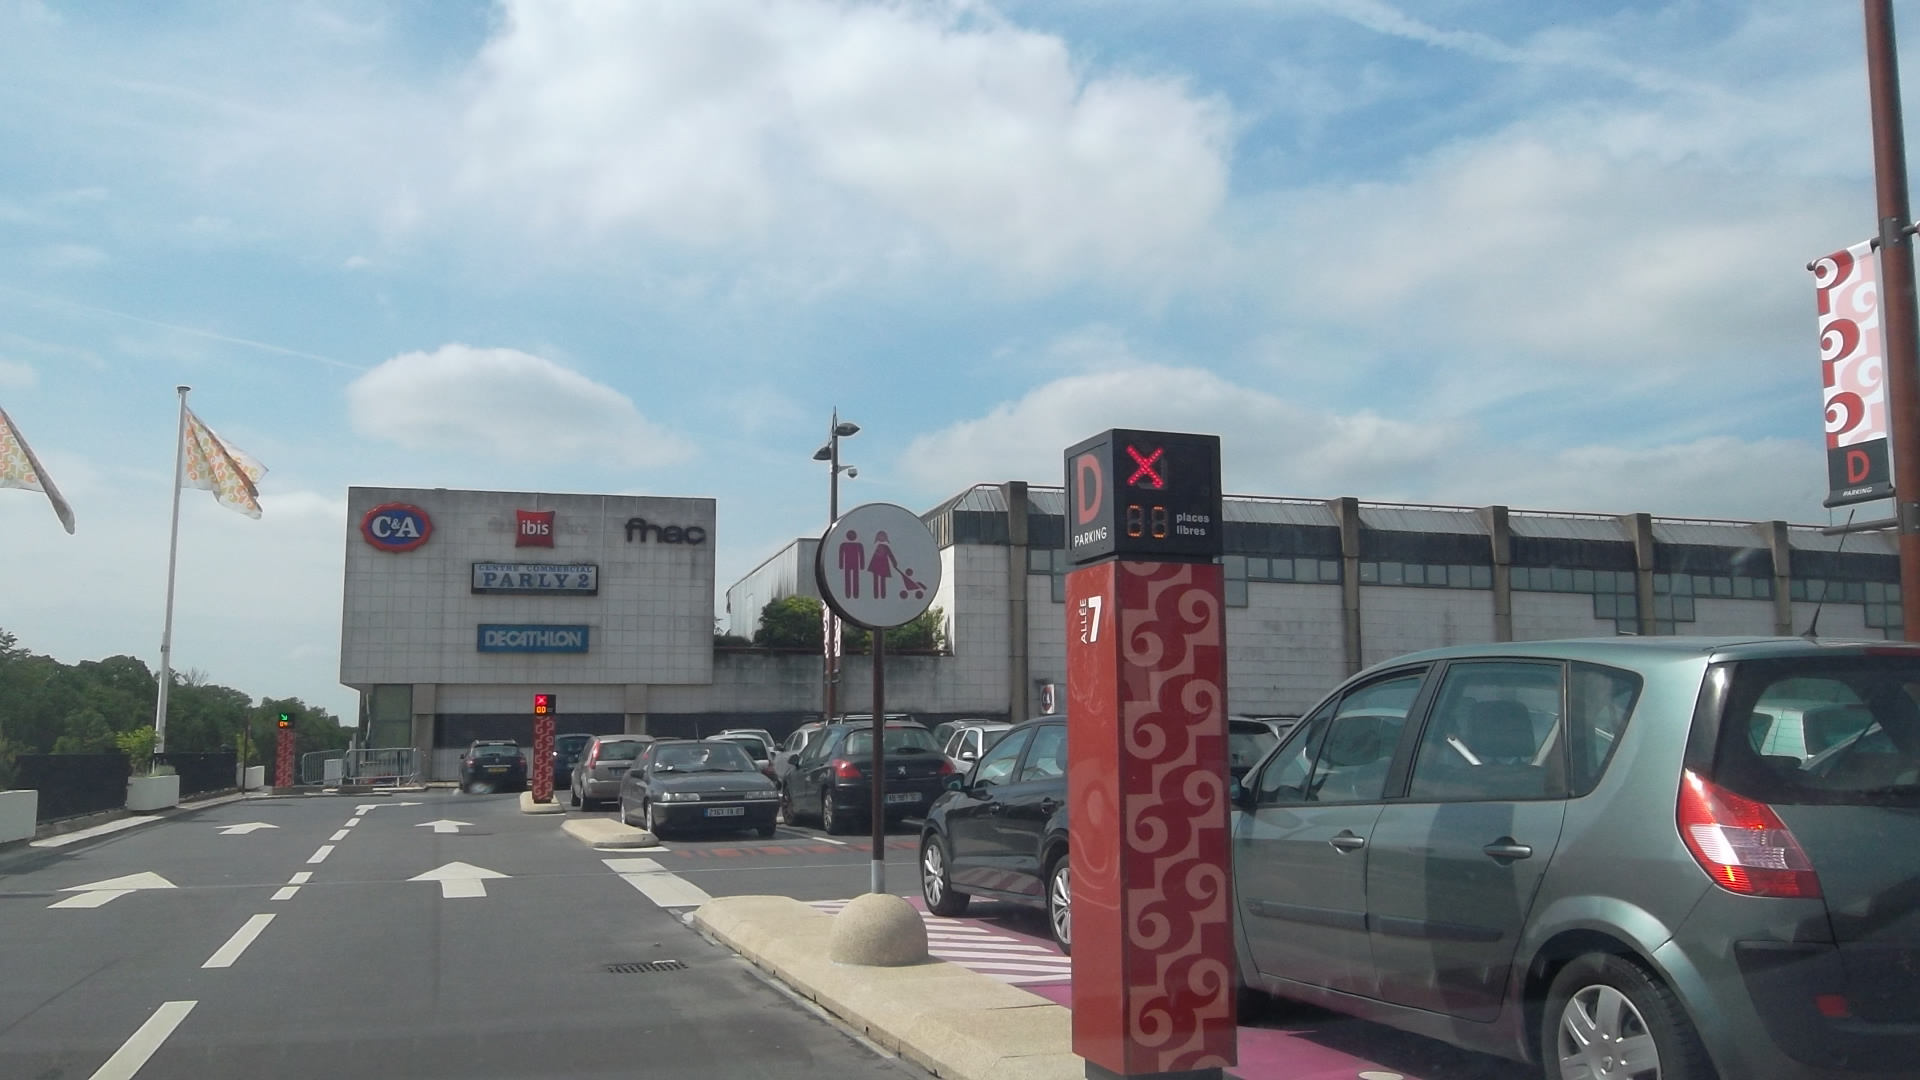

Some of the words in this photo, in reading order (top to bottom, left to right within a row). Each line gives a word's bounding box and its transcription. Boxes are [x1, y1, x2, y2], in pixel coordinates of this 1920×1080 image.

[1847, 450, 1870, 483] D
[1076, 453, 1103, 525] D
[1843, 487, 1872, 496] PARKING
[1176, 512, 1210, 524] places
[371, 515, 419, 538] C&A
[522, 519, 549, 535] ibis
[625, 517, 704, 543] fnac
[1176, 525, 1206, 536] libres
[1074, 526, 1107, 547] PARKING
[478, 564, 520, 572] CENTRE
[526, 565, 593, 573] COMMERCIAL
[483, 573, 569, 587] PARLY
[577, 573, 590, 588] 2
[1078, 598, 1088, 644] ALLÉE
[1088, 595, 1102, 643] 7
[485, 631, 581, 645] DECATHLON
[536, 706, 546, 714] 00
